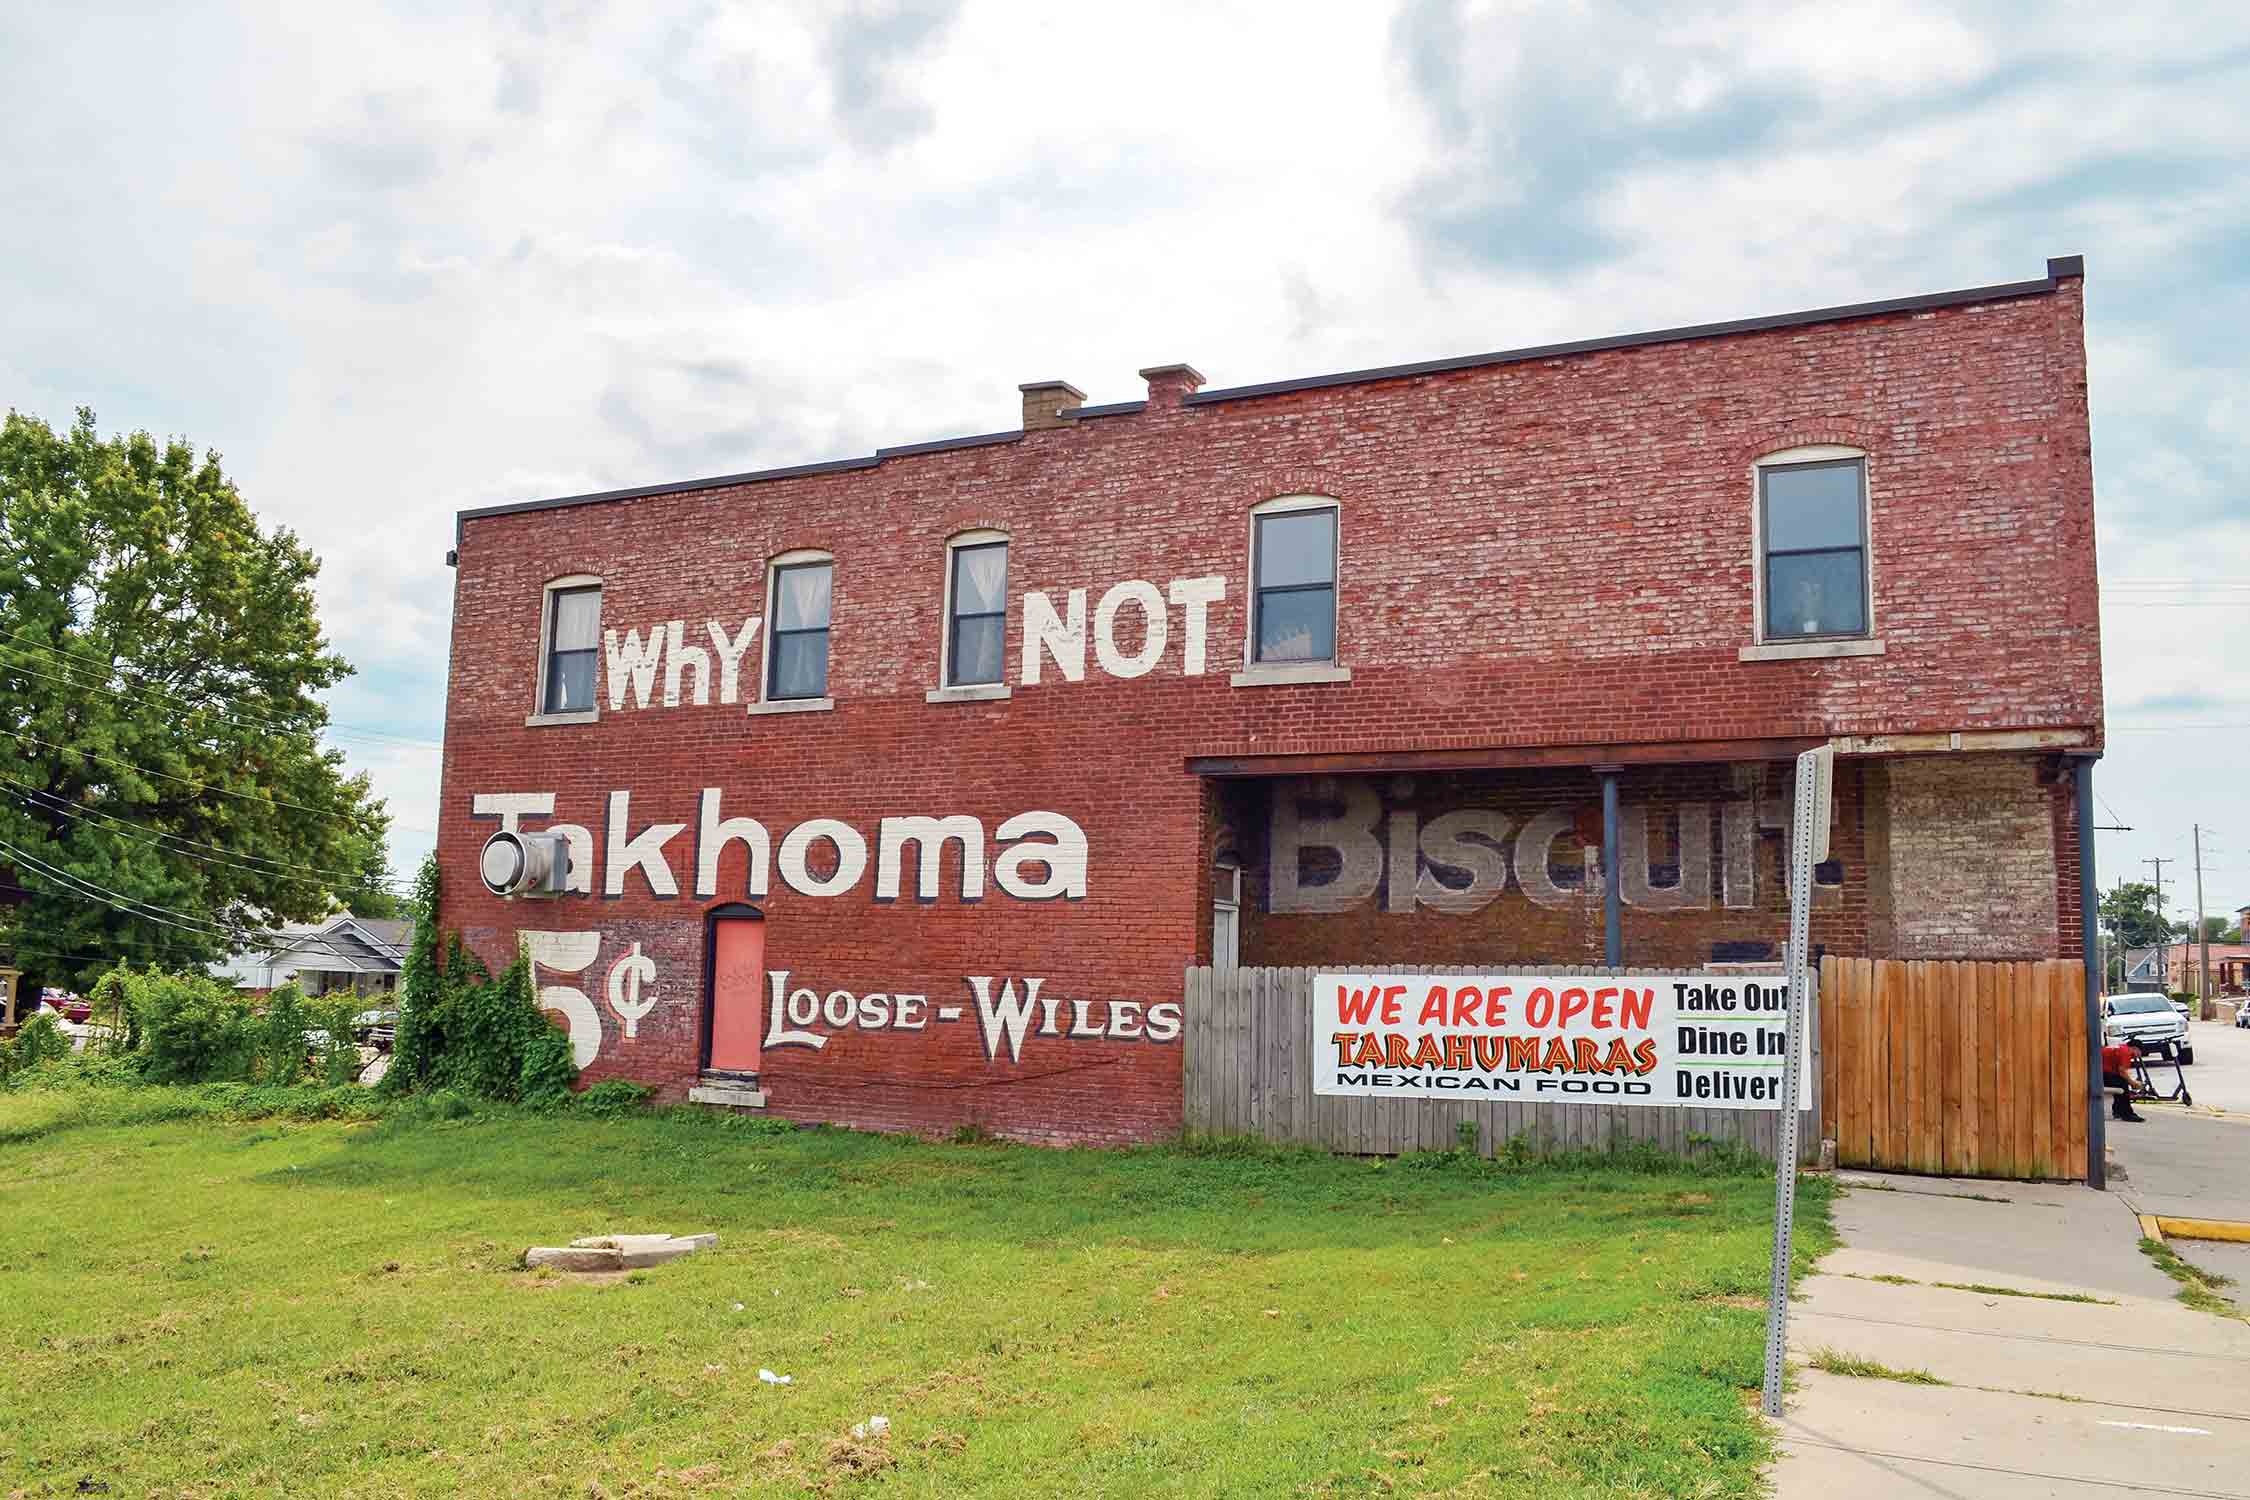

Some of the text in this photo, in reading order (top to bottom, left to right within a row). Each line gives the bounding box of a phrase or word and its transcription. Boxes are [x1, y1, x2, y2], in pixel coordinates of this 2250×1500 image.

[1019, 573, 1228, 686] NOT
[1337, 985, 1655, 1030] WE ARE OPEN
[1673, 983, 1737, 1011] Take
[1331, 1031, 1658, 1077] TARAHUMARAS
[1677, 1026, 1786, 1056] Dine In
[1336, 1073, 1652, 1095] MEXICAN FOOD
[1676, 1070, 1784, 1100] Deliver
